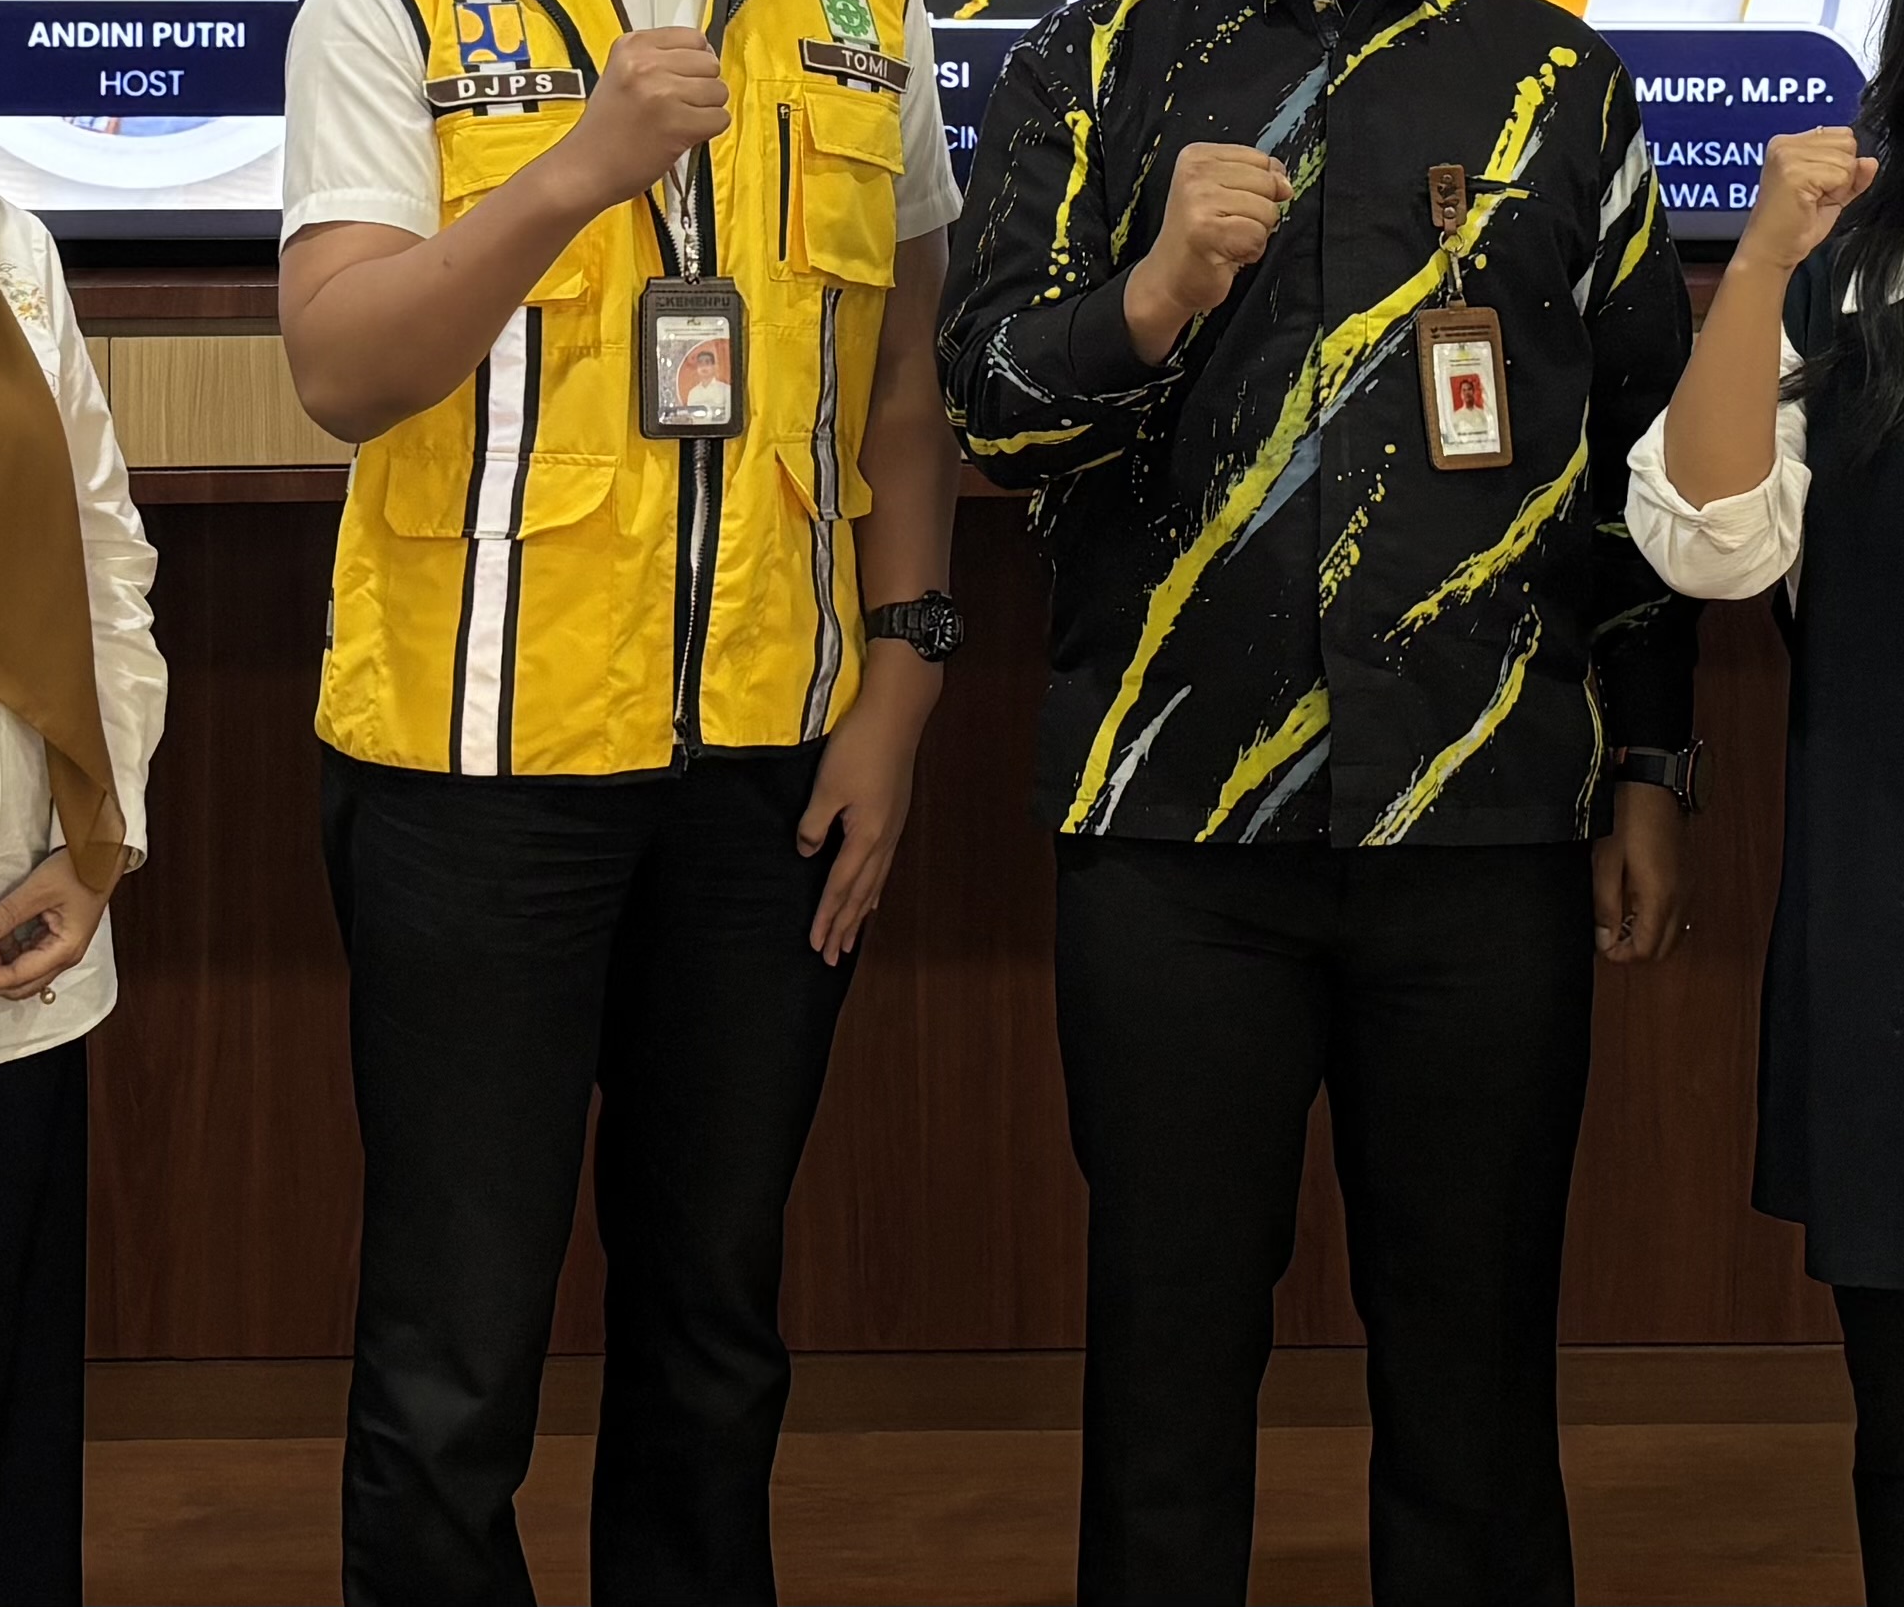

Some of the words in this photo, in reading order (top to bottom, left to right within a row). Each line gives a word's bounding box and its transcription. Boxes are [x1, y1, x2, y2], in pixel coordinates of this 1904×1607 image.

[27, 21, 144, 48] ANDINI
[152, 21, 246, 48] PUTRI
[841, 49, 888, 79] TOMI
[100, 69, 185, 97] HOST
[456, 73, 553, 99] DJPS
[1635, 77, 1734, 107] MURP,
[1741, 77, 1834, 104] M.P.P.
[1646, 141, 1764, 167] LAKSAN
